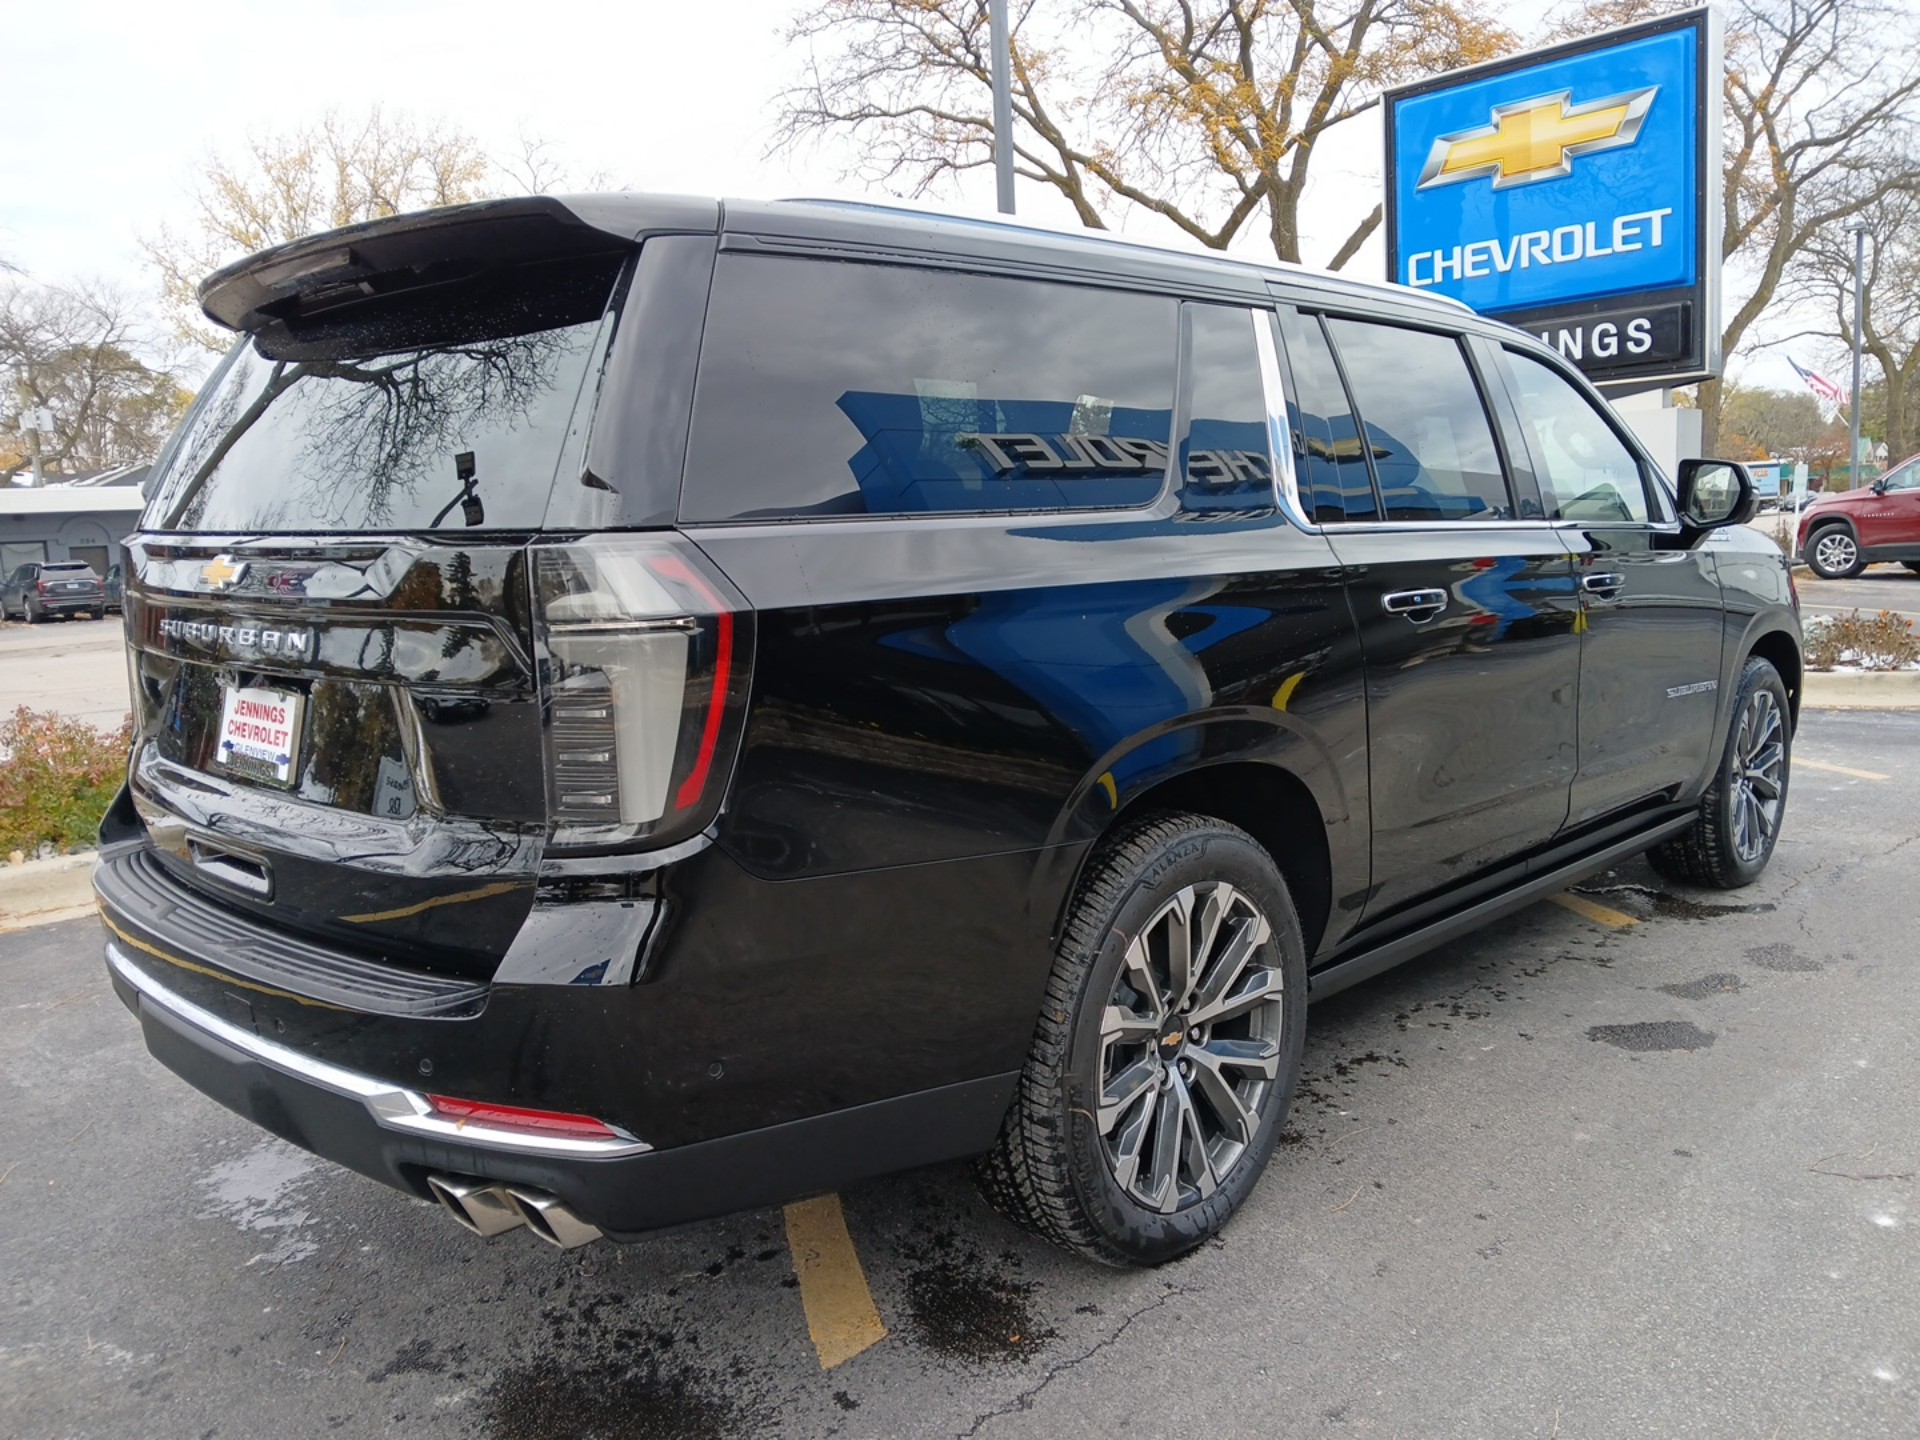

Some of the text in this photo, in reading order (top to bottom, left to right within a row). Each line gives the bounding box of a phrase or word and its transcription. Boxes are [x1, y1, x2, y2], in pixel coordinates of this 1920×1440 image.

[1408, 207, 1672, 287] CHEVROLET
[158, 618, 308, 652] SUBURBAN
[1665, 679, 1719, 699] SUBURBAN
[234, 699, 286, 725] JENNINGS
[227, 719, 289, 748] CHEVROLET
[233, 742, 277, 763] GLENVIEW
